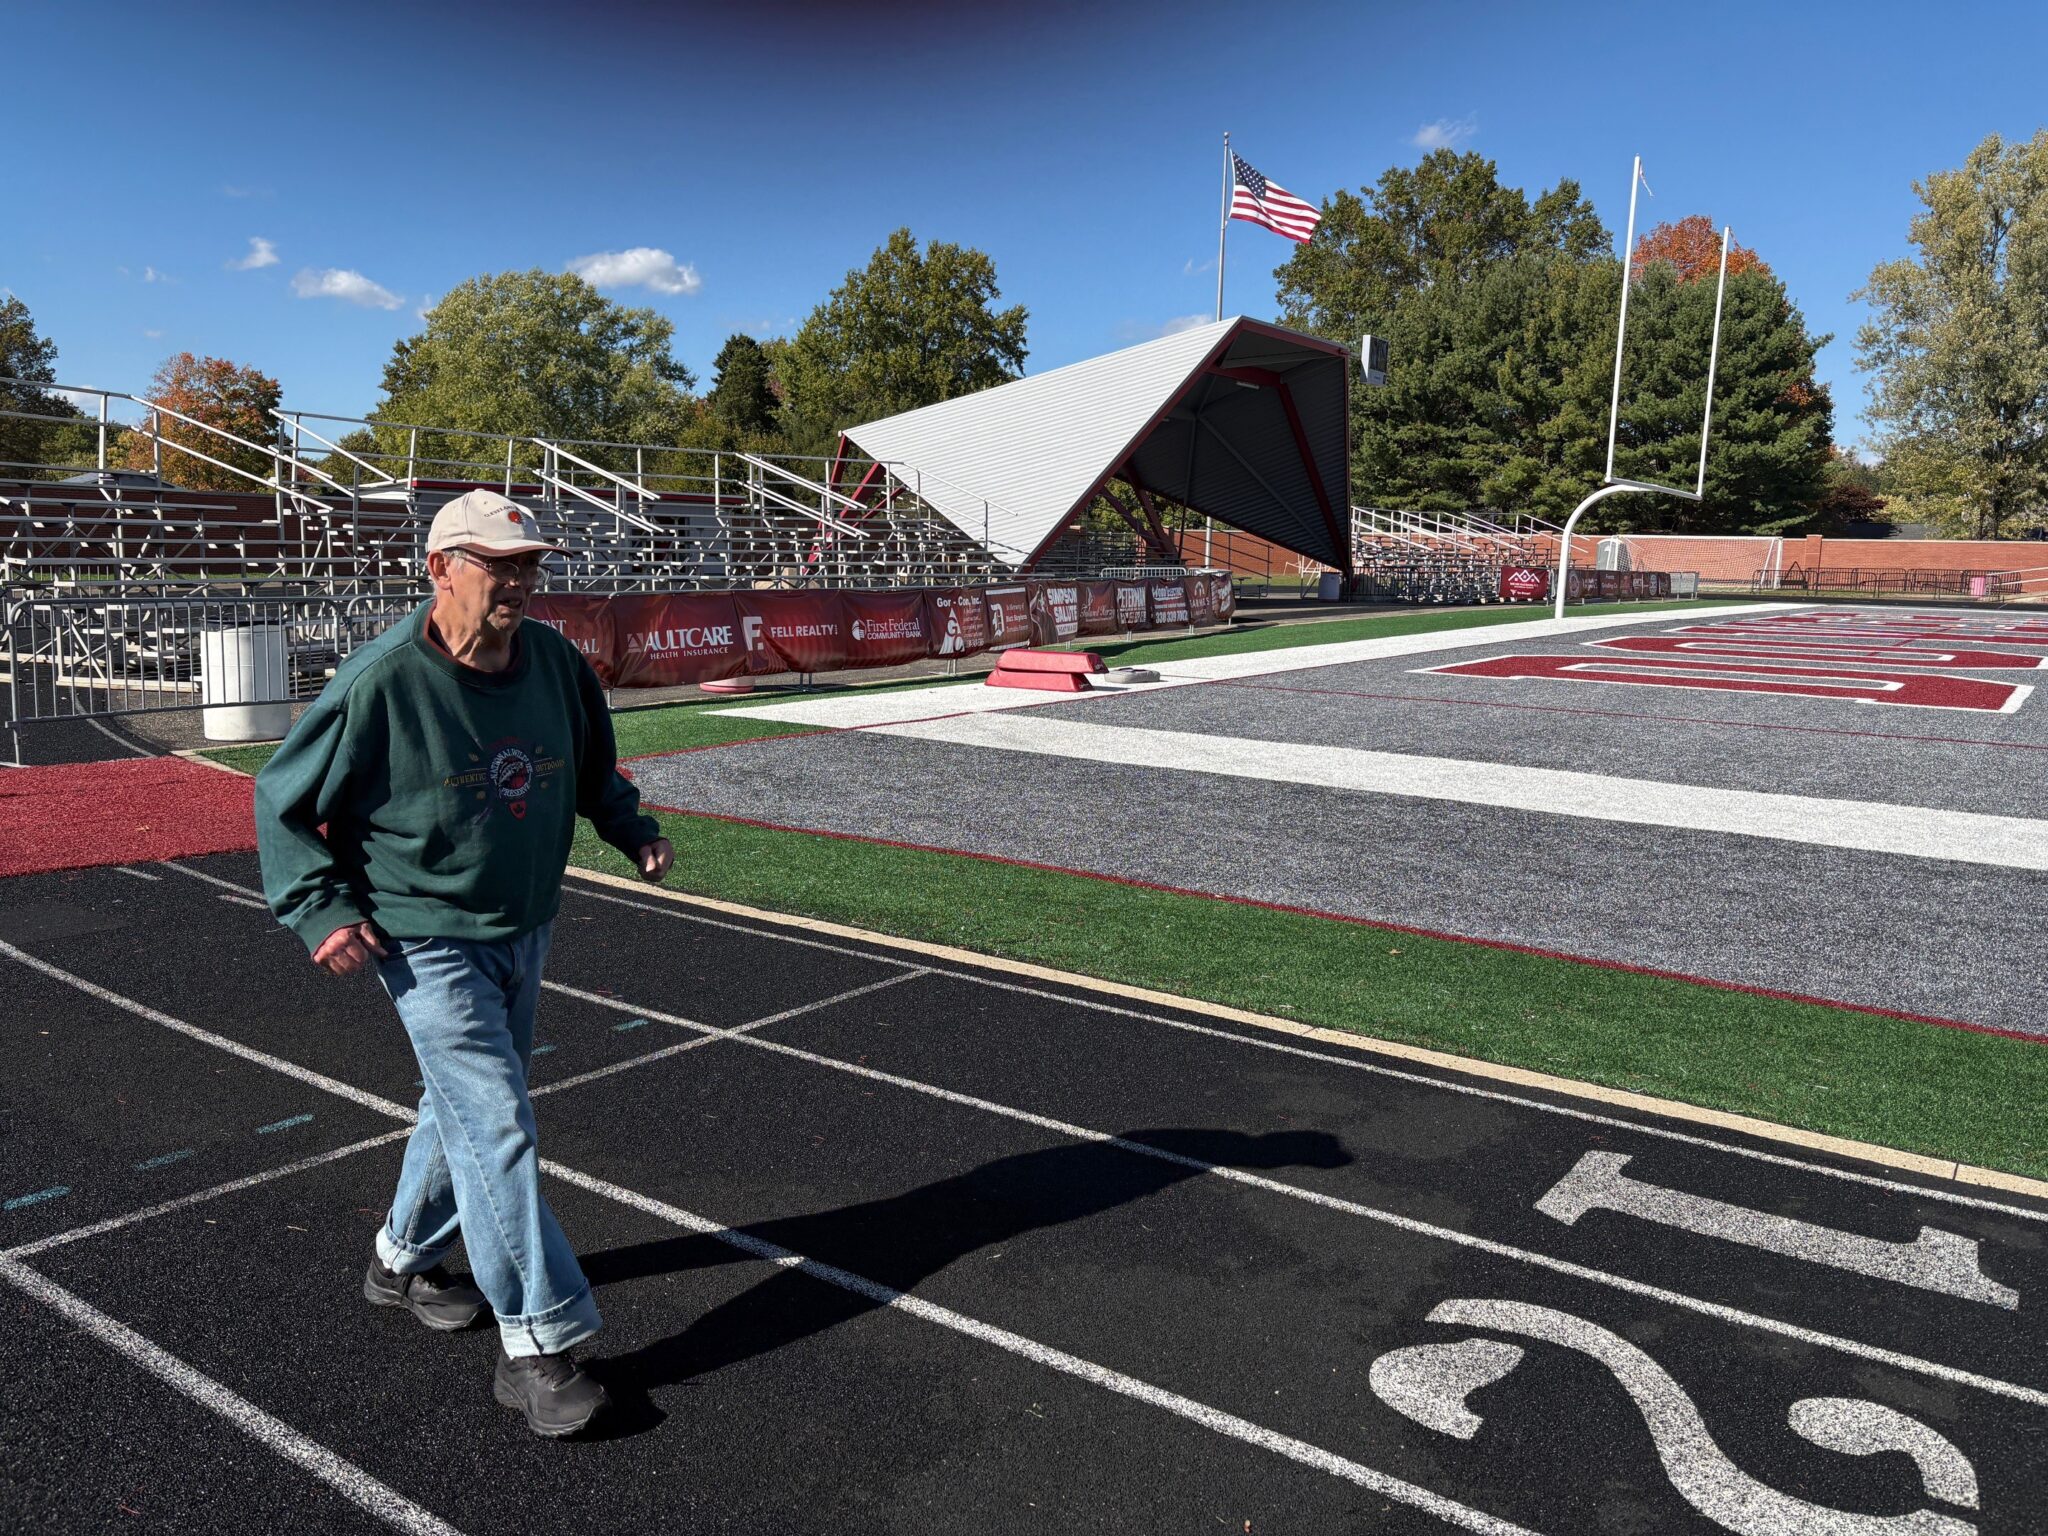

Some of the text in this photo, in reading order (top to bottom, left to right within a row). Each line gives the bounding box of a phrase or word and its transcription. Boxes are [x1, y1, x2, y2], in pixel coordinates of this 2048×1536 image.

[936, 597, 951, 608] Gor
[770, 626, 794, 638] FELL
[797, 624, 834, 637] REALTY
[867, 618, 920, 632] First Federal
[643, 625, 734, 653] AULTCARE
[867, 630, 922, 640] COMMUNITY BANK
[650, 646, 729, 660] HEALTH INSURANCE
